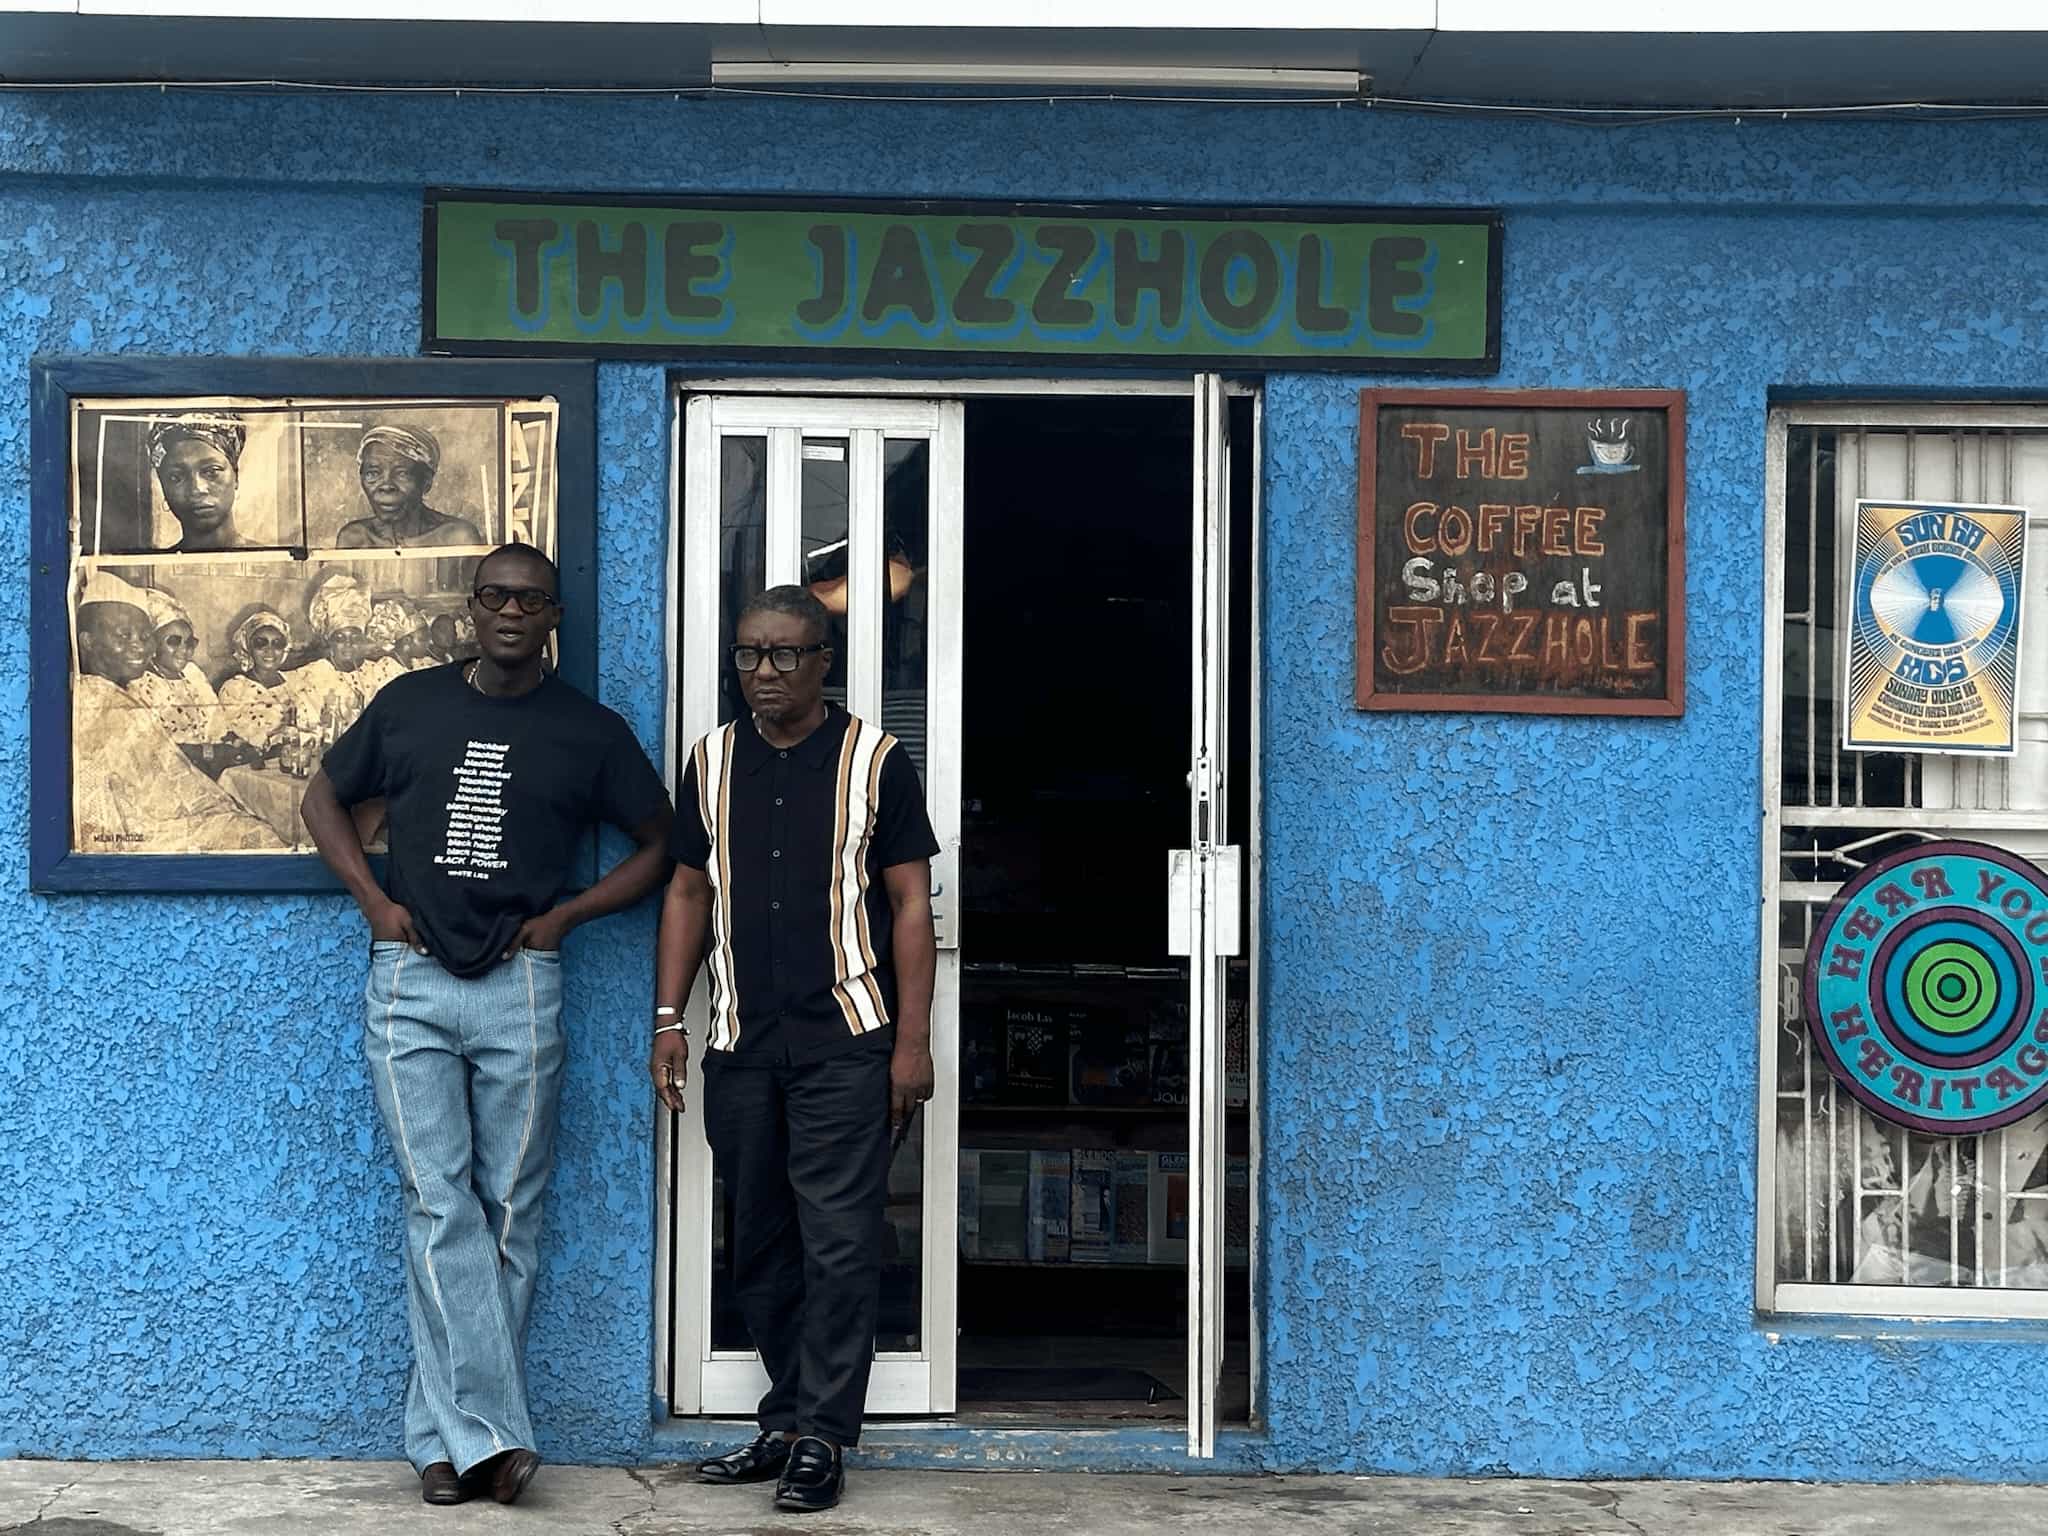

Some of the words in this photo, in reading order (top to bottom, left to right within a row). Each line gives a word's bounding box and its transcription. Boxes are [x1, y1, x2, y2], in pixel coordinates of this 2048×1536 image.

[493, 218, 734, 332] THE
[795, 223, 1436, 346] JAZZHOLE
[1402, 423, 1530, 479] THE
[1404, 502, 1606, 557] COFFEE
[1895, 514, 1945, 545] SUN
[1402, 557, 1528, 614] Shop
[1552, 568, 1602, 607] at
[1382, 607, 1658, 675] JAZZHOLE
[1884, 677, 1928, 703] SUNDAY
[433, 855, 467, 865] BLACK
[470, 857, 508, 869] POWER
[1828, 866, 1955, 981] HEAR
[1976, 868, 2048, 986] YOU
